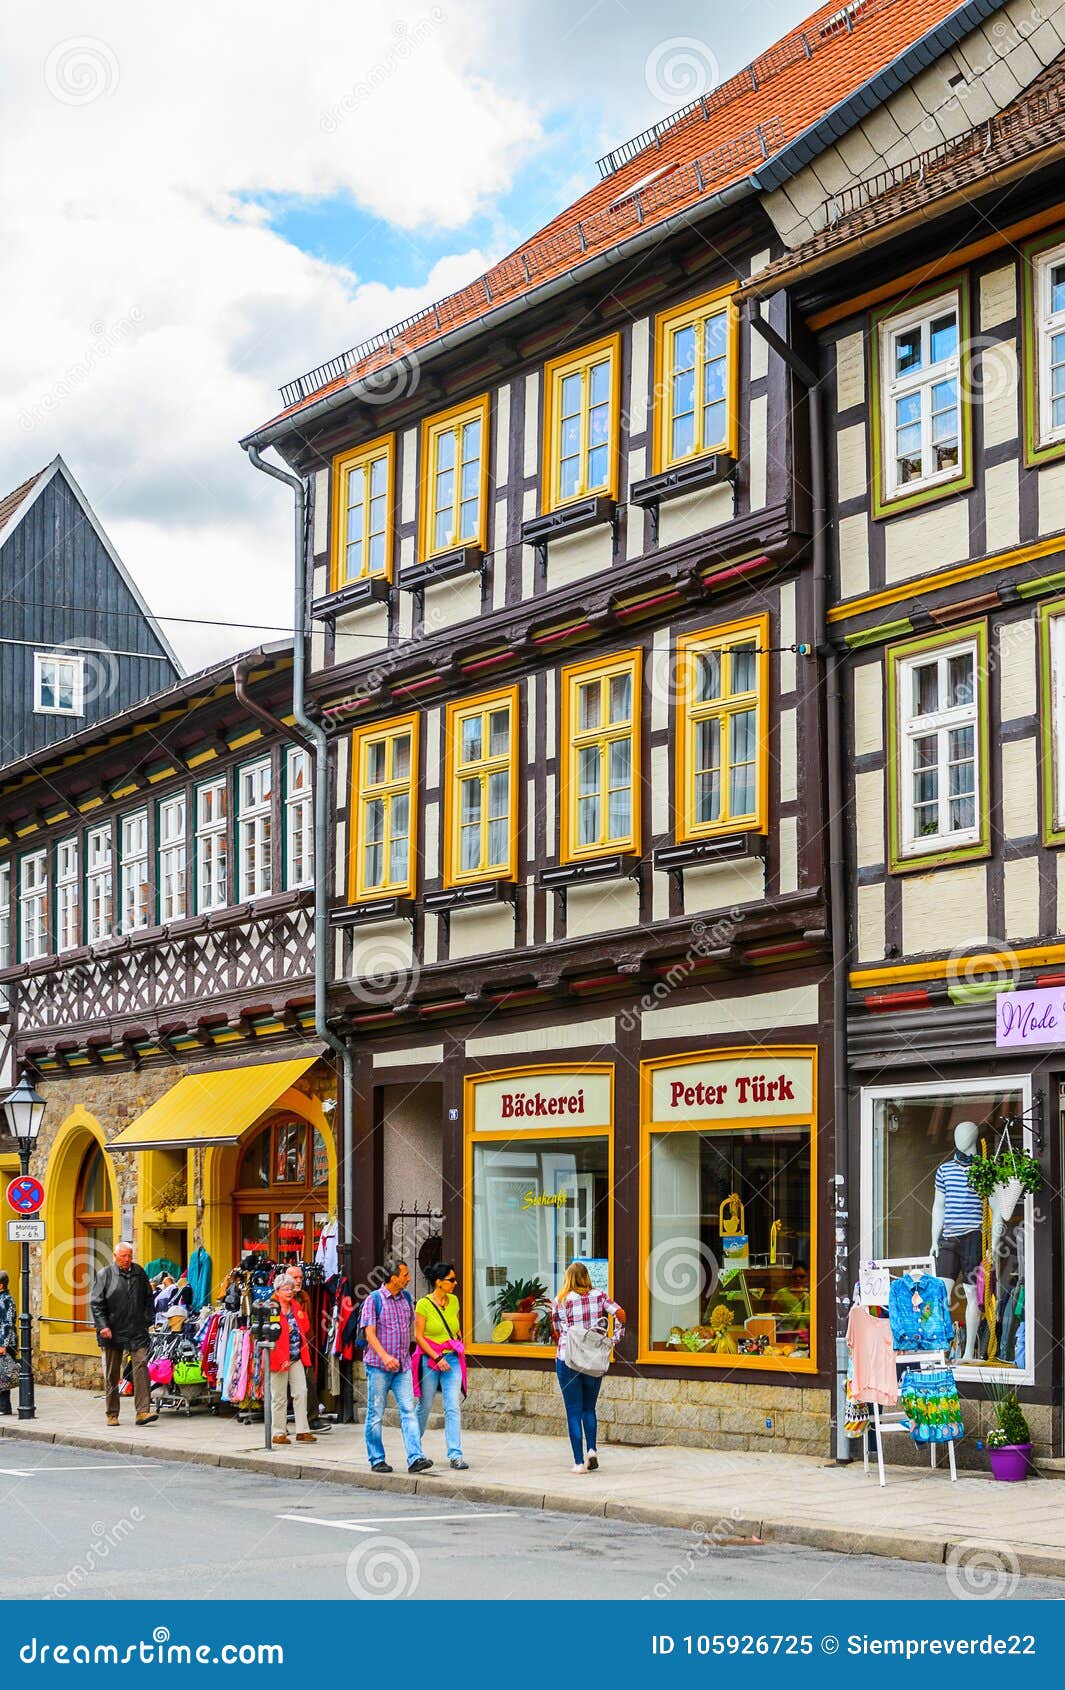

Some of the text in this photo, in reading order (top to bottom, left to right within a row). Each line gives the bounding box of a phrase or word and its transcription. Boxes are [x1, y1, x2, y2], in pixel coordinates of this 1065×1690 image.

[1002, 1001, 1057, 1037] Mode
[501, 1089, 585, 1118] Bäckerei
[670, 1074, 795, 1107] Peter Türk
